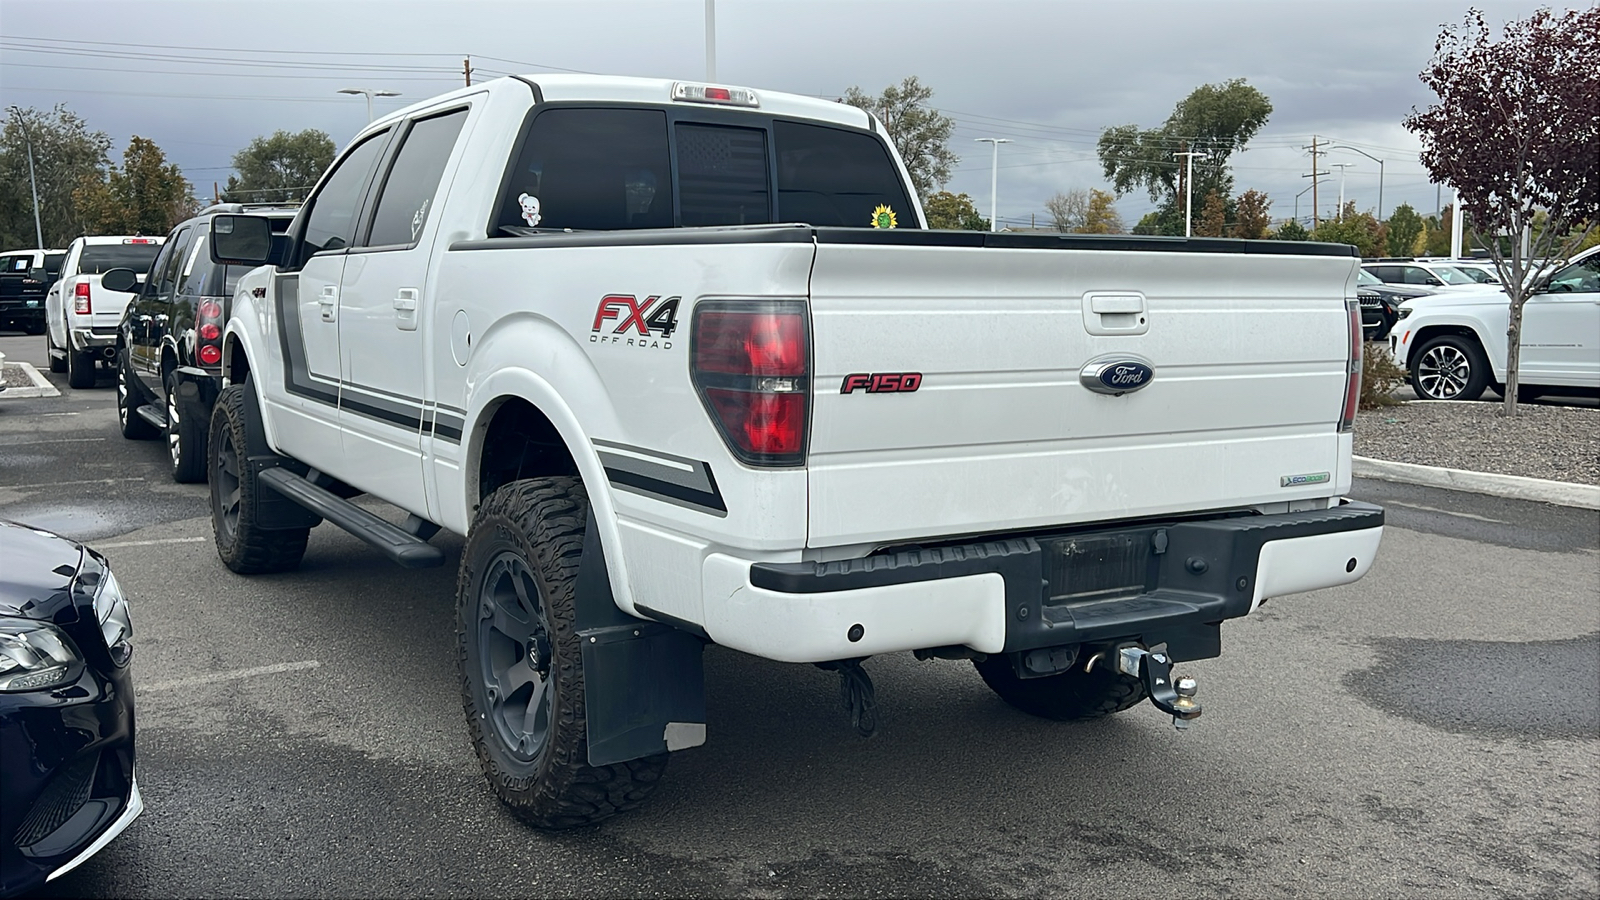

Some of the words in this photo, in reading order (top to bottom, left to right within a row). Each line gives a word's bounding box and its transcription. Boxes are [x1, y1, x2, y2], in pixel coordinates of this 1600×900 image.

[592, 294, 682, 338] FX4
[590, 335, 619, 344] OFF
[627, 338, 672, 349] ROAD
[840, 372, 922, 394] F-150
[1111, 365, 1144, 385] Ford
[1292, 474, 1327, 484] ECOBOOST
